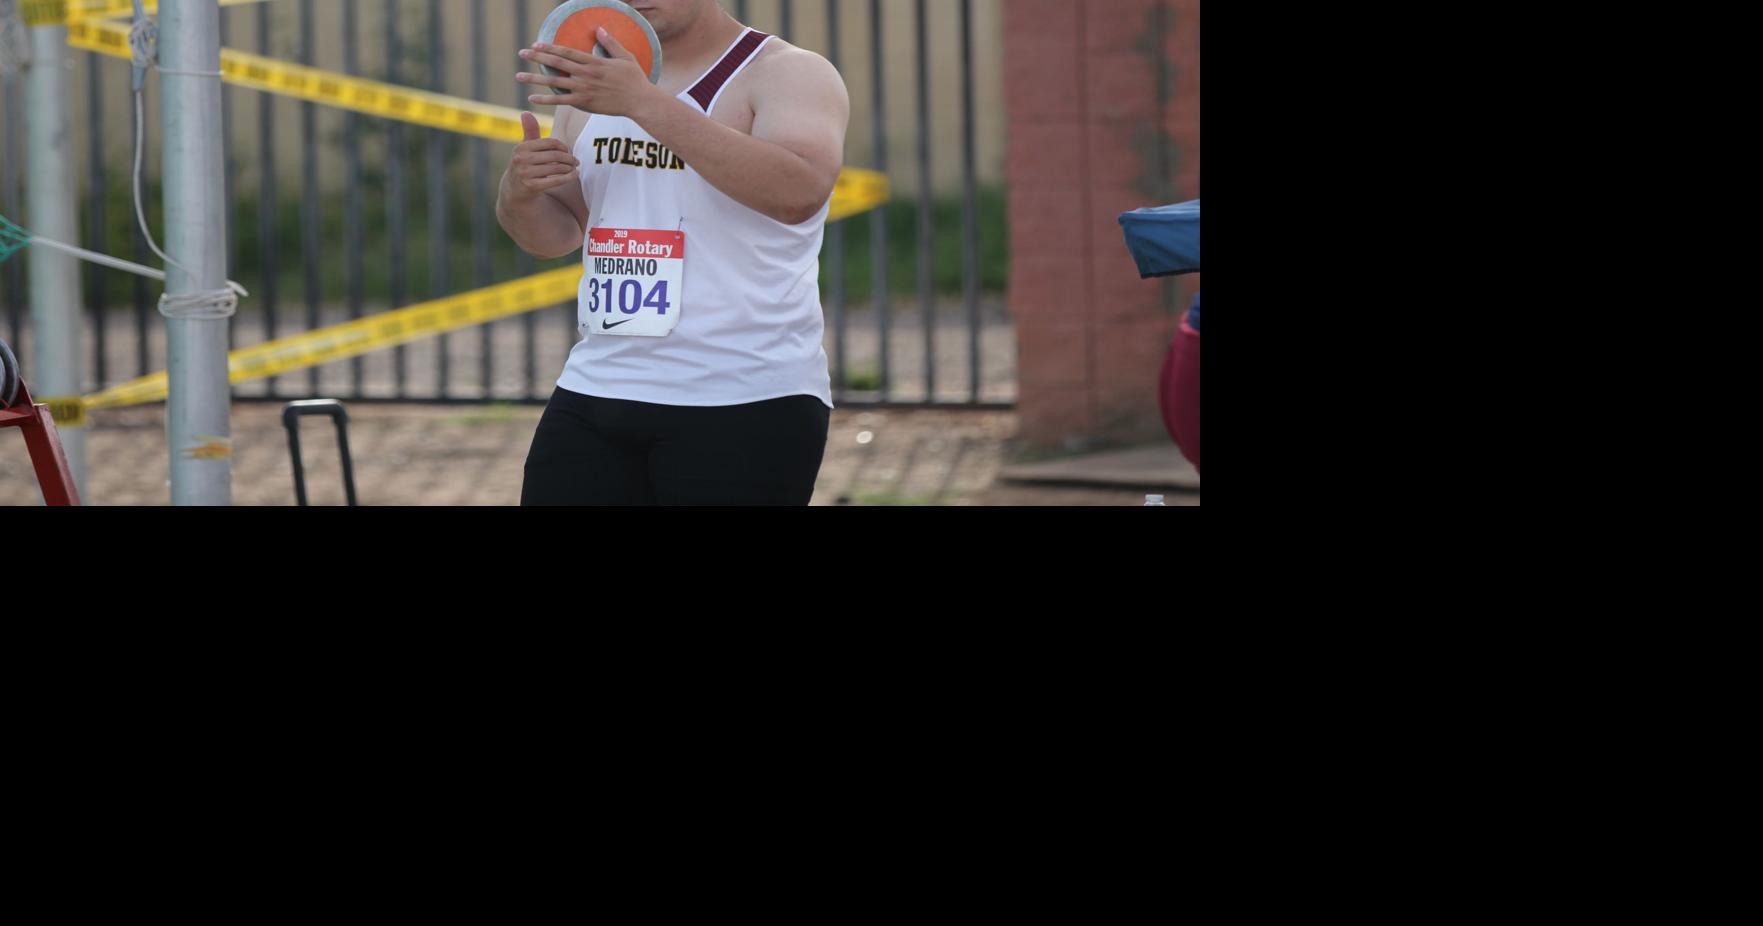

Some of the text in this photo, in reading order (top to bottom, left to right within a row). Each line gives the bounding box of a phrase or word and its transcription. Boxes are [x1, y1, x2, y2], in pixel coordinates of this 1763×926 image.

[613, 229, 628, 238] 2019
[589, 238, 673, 258] Chandler Rotary
[594, 257, 658, 276] MEDRANO
[588, 277, 671, 316] 3104
